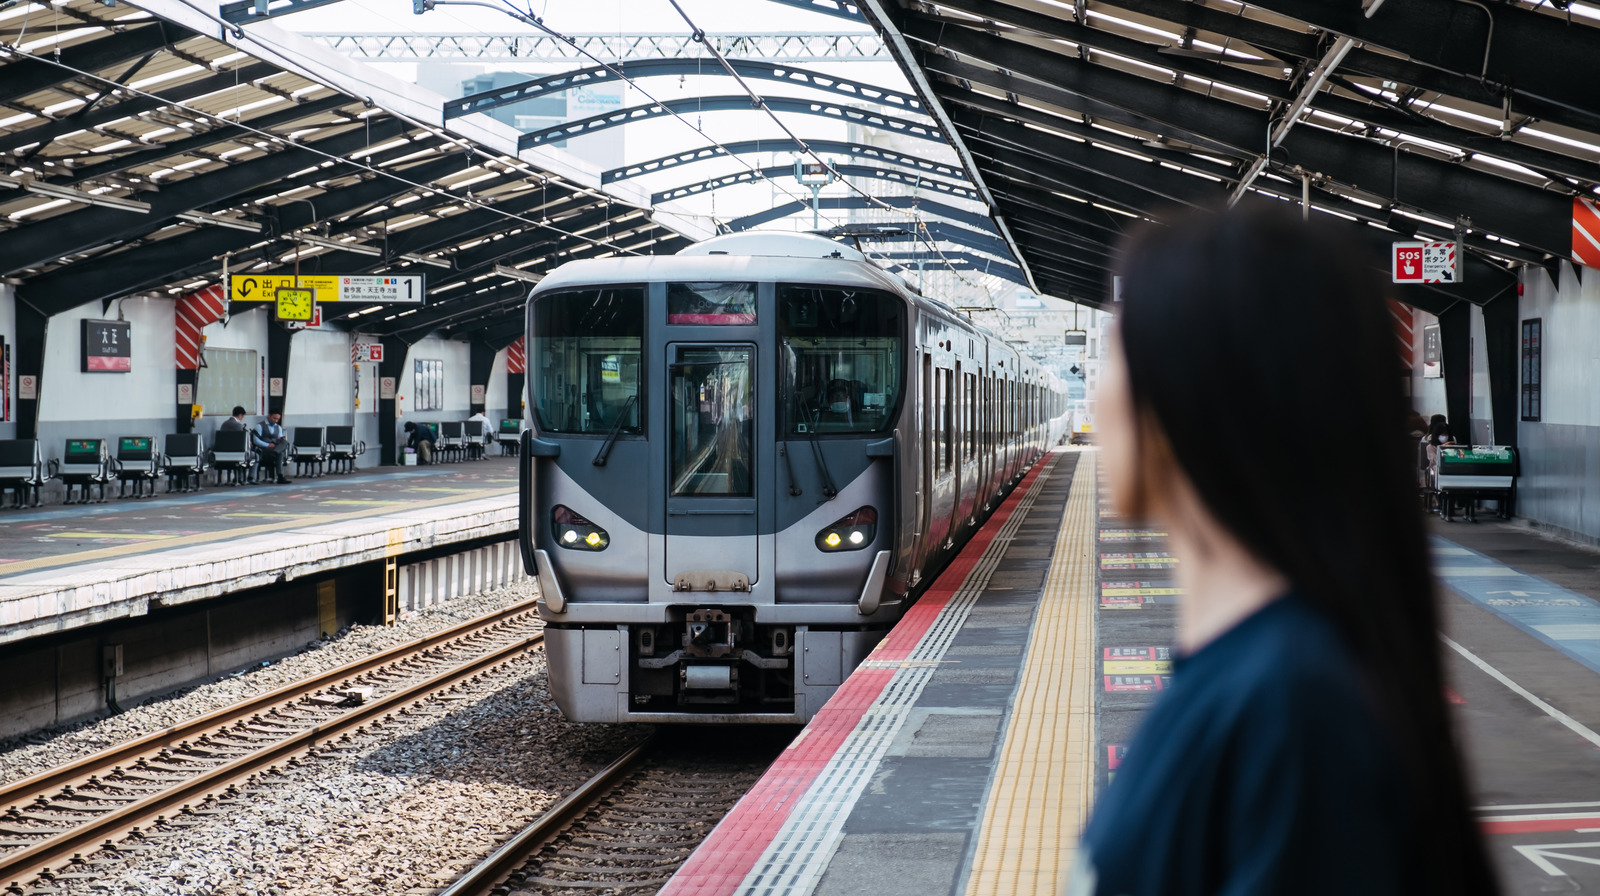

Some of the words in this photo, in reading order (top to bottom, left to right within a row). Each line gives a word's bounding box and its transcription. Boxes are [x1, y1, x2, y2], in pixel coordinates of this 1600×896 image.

[1399, 251, 1420, 260] SOS
[343, 286, 385, 294] 新今宮・天王寺
[403, 278, 413, 299] 1
